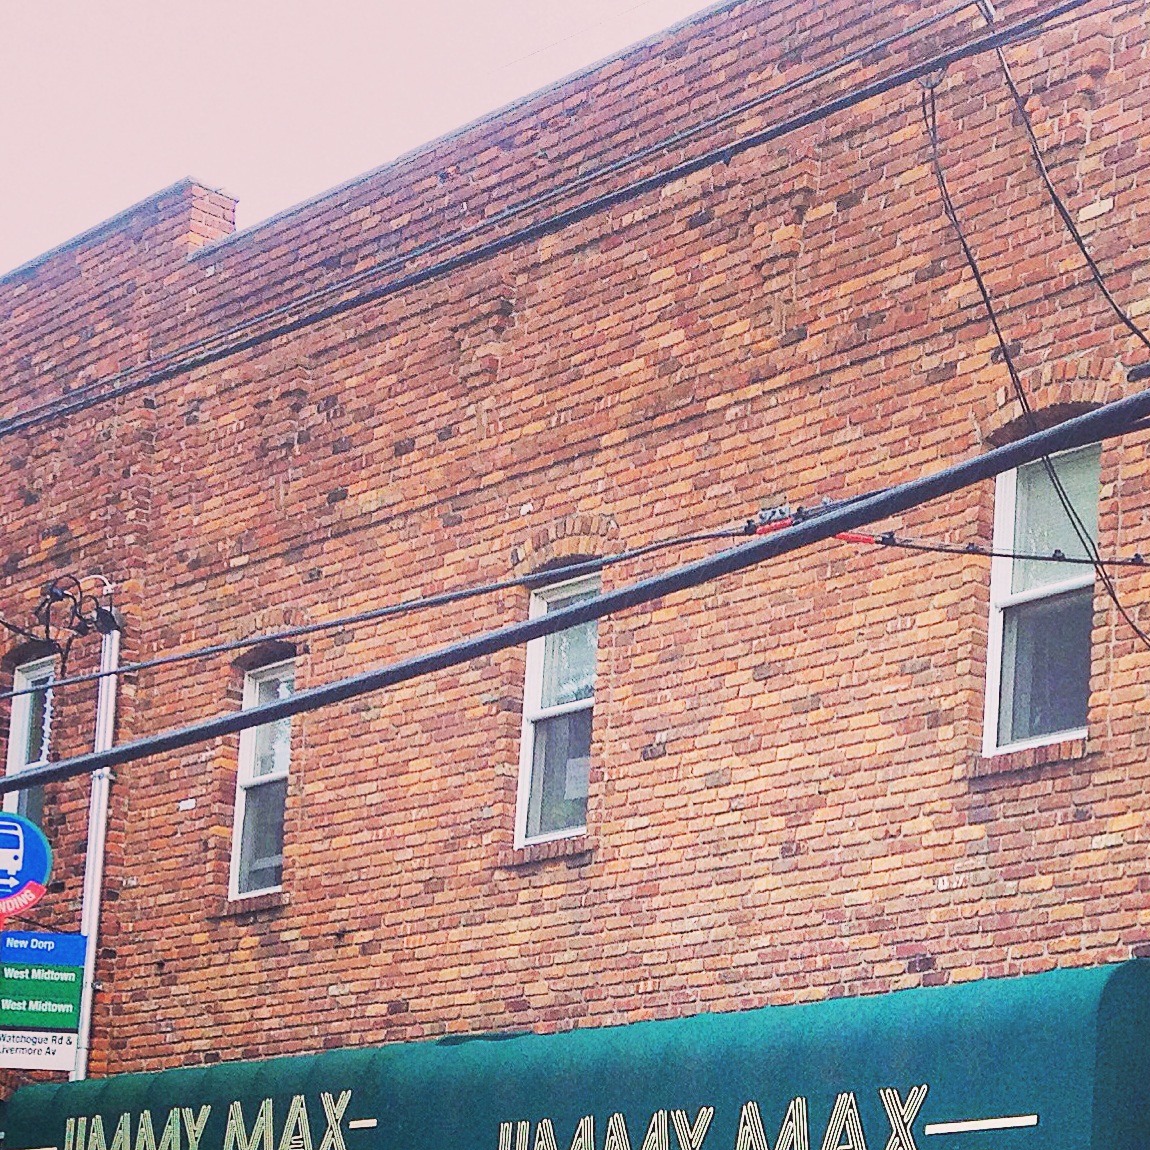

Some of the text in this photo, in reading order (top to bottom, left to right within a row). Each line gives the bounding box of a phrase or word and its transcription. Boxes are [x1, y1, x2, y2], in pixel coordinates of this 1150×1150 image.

[6, 938, 55, 951] New Dorp
[4, 967, 76, 981] West Midtown
[1, 999, 73, 1012] West Midtown
[52, 1036, 63, 1045] Rd
[66, 1036, 73, 1045] &
[45, 1047, 57, 1055] Av
